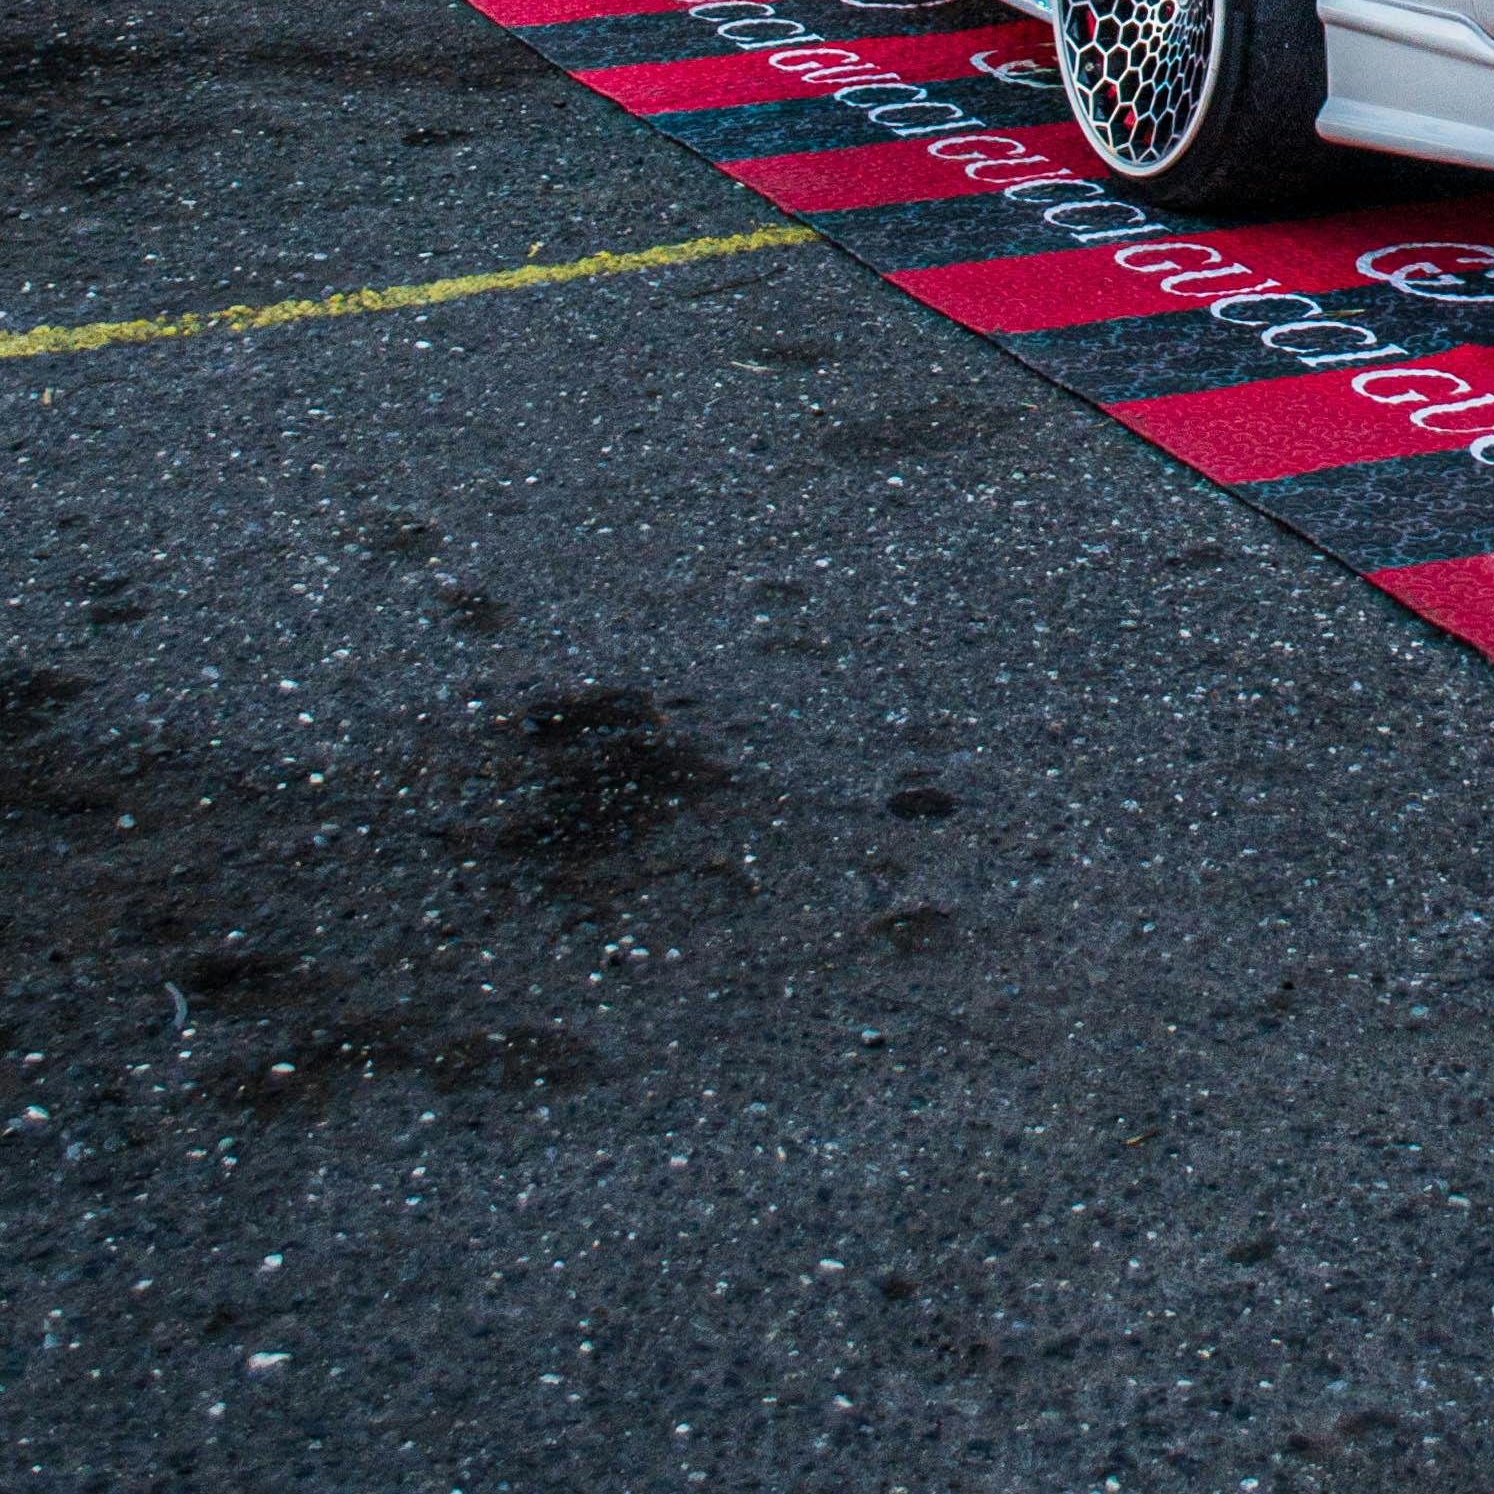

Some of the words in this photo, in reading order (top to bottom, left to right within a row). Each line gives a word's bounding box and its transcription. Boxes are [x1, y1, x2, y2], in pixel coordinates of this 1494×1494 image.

[768, 47, 987, 136] GUCCI
[927, 135, 1173, 243] GUCCI
[1114, 242, 1409, 367] GUCCI
